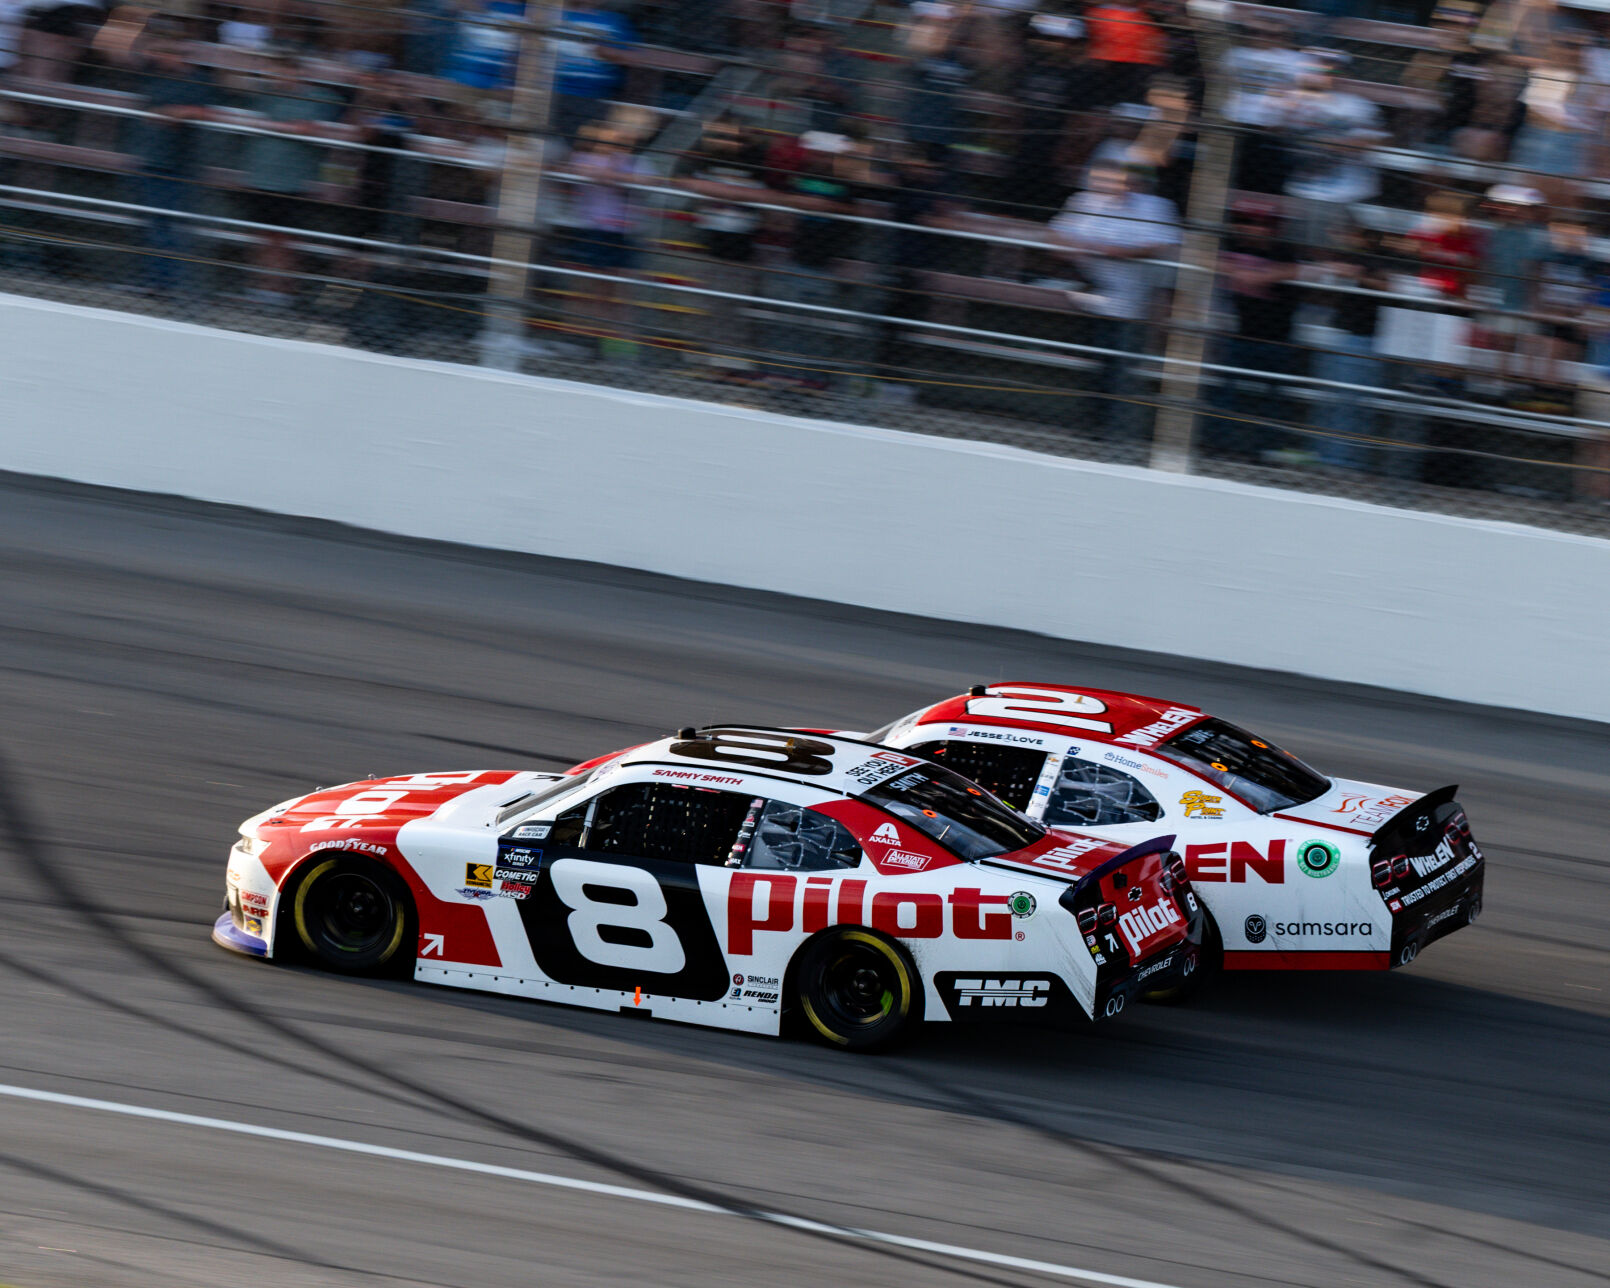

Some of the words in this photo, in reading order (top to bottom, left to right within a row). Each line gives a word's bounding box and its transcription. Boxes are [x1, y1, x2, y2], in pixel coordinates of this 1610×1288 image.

[1113, 706, 1205, 747] WHELEN
[967, 731, 1001, 740] JESSE
[1013, 736, 1044, 745] LOVE
[652, 769, 700, 780] SAMMY
[701, 774, 744, 785] SMITH
[889, 772, 930, 792] SMITH
[869, 836, 901, 847] AXALTA
[1409, 833, 1455, 878] WHELEN
[1468, 841, 1482, 859] 2
[504, 852, 534, 865] xfinity
[495, 869, 537, 882] COMETIC
[500, 890, 527, 900] MSD
[501, 881, 531, 894] Holley
[1401, 888, 1425, 906] TRUSTED
[1421, 885, 1431, 896] TO
[1186, 892, 1198, 912] 8
[550, 858, 686, 974] 8
[1275, 920, 1373, 936] samsara
[1137, 956, 1173, 982] CHEVROLET
[747, 975, 779, 985] SINCLAIR
[743, 990, 779, 1000] RENDA
[954, 979, 1050, 1007] TMC
